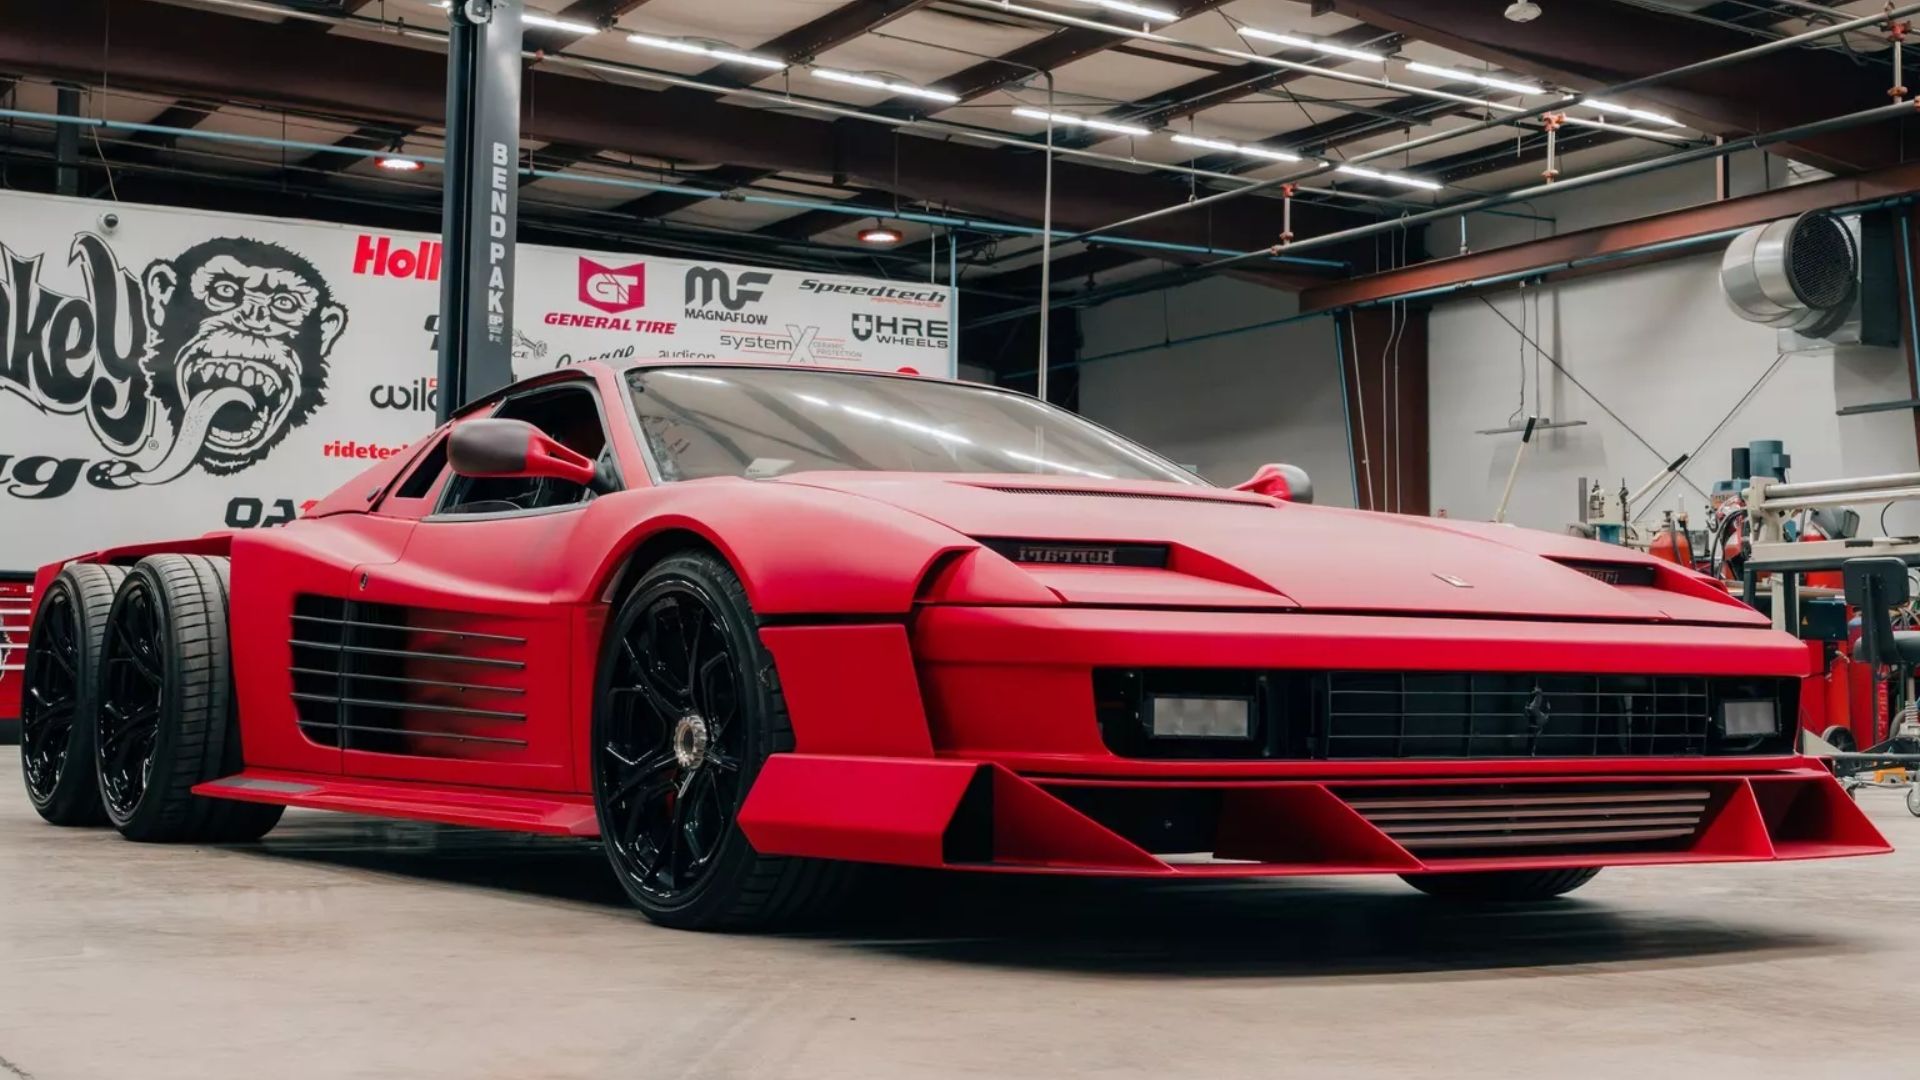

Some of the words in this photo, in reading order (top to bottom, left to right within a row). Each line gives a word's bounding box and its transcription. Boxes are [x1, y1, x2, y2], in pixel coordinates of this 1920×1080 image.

[489, 142, 508, 313] BENDPAK
[798, 279, 947, 302] Speedtech
[544, 312, 632, 331] GENERAL
[635, 320, 678, 335] TIRE
[684, 308, 768, 325] MAGNAFLOW
[875, 315, 949, 339] HRE
[0, 231, 157, 457] key
[876, 335, 949, 349] WHEELS
